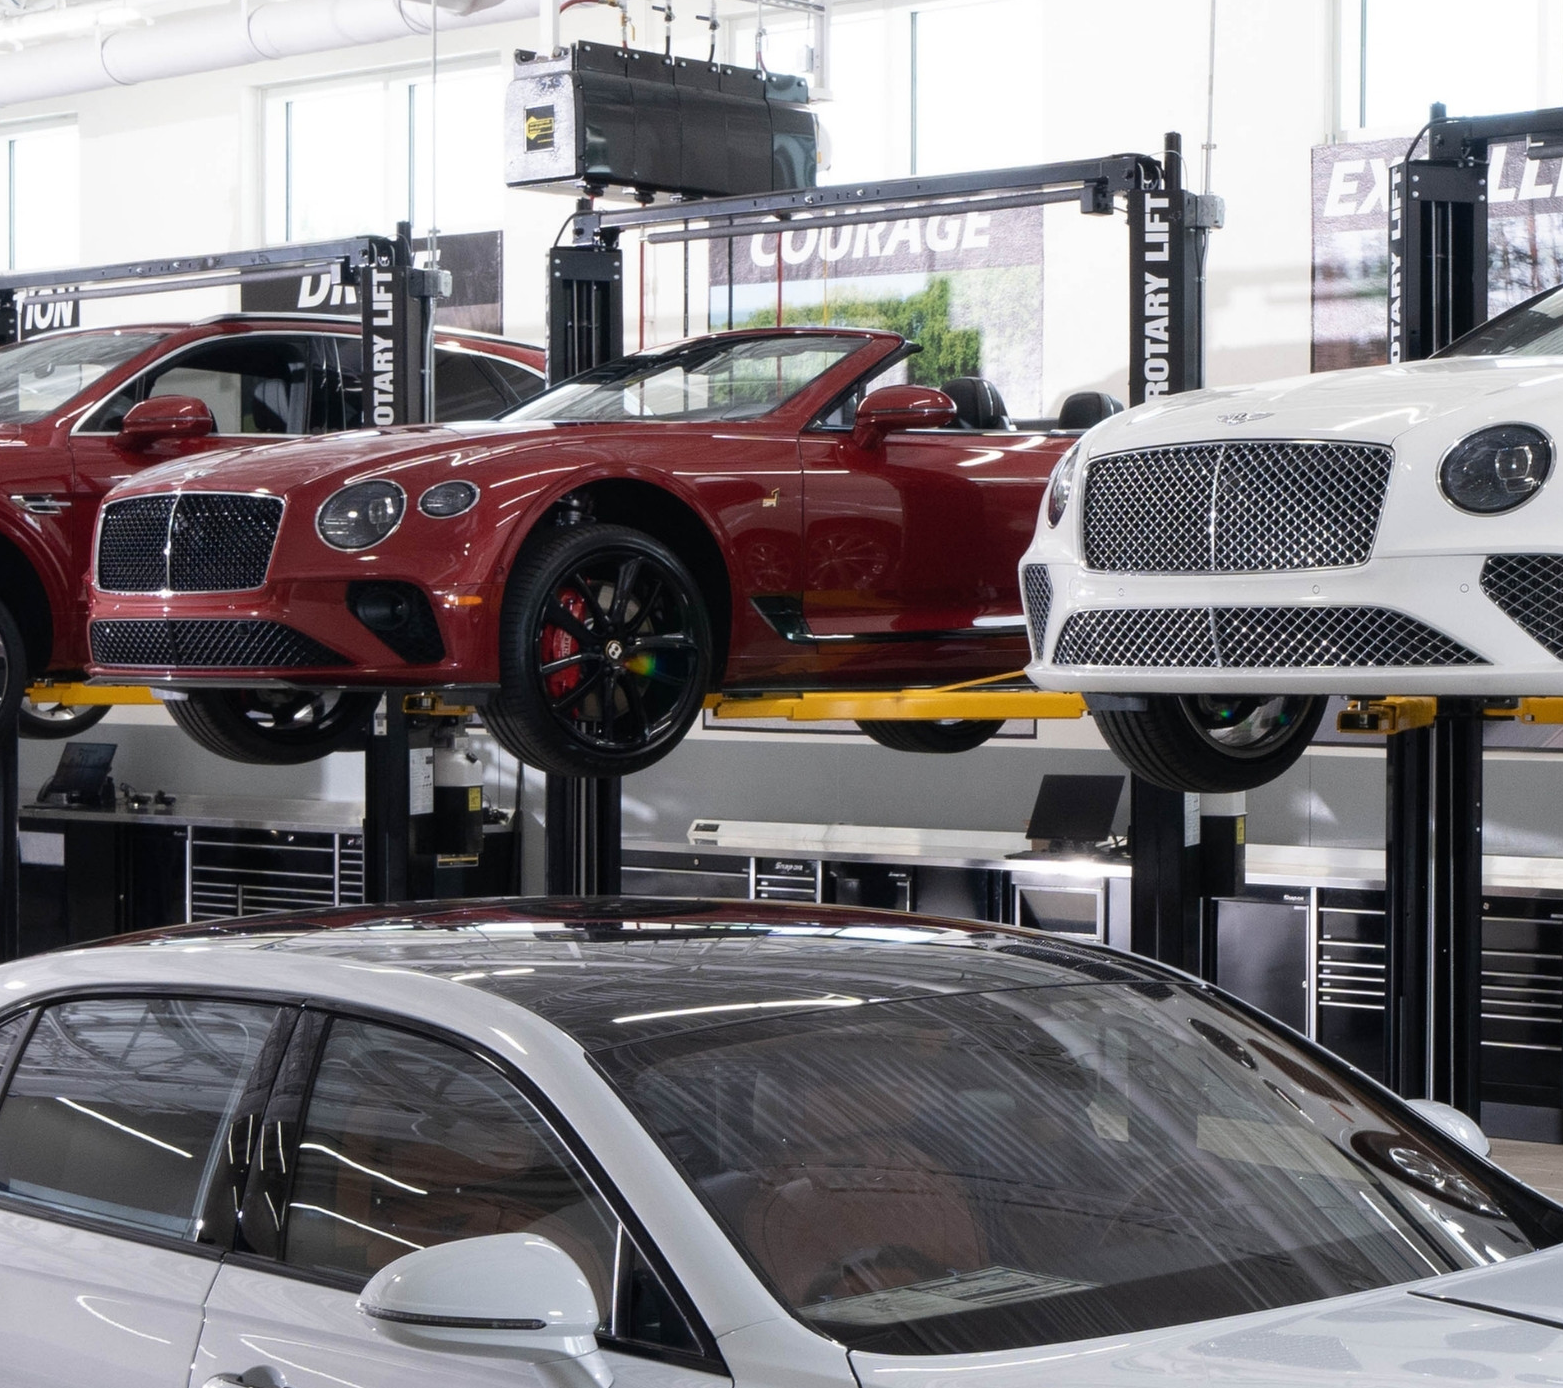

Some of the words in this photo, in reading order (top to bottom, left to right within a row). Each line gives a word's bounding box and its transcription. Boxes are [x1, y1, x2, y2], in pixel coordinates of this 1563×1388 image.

[750, 196, 997, 268] COURAGE
[1144, 193, 1169, 261] LIFT
[1391, 167, 1402, 241] LIFT
[372, 269, 393, 326] LIFT
[1144, 272, 1169, 404] ROTARY
